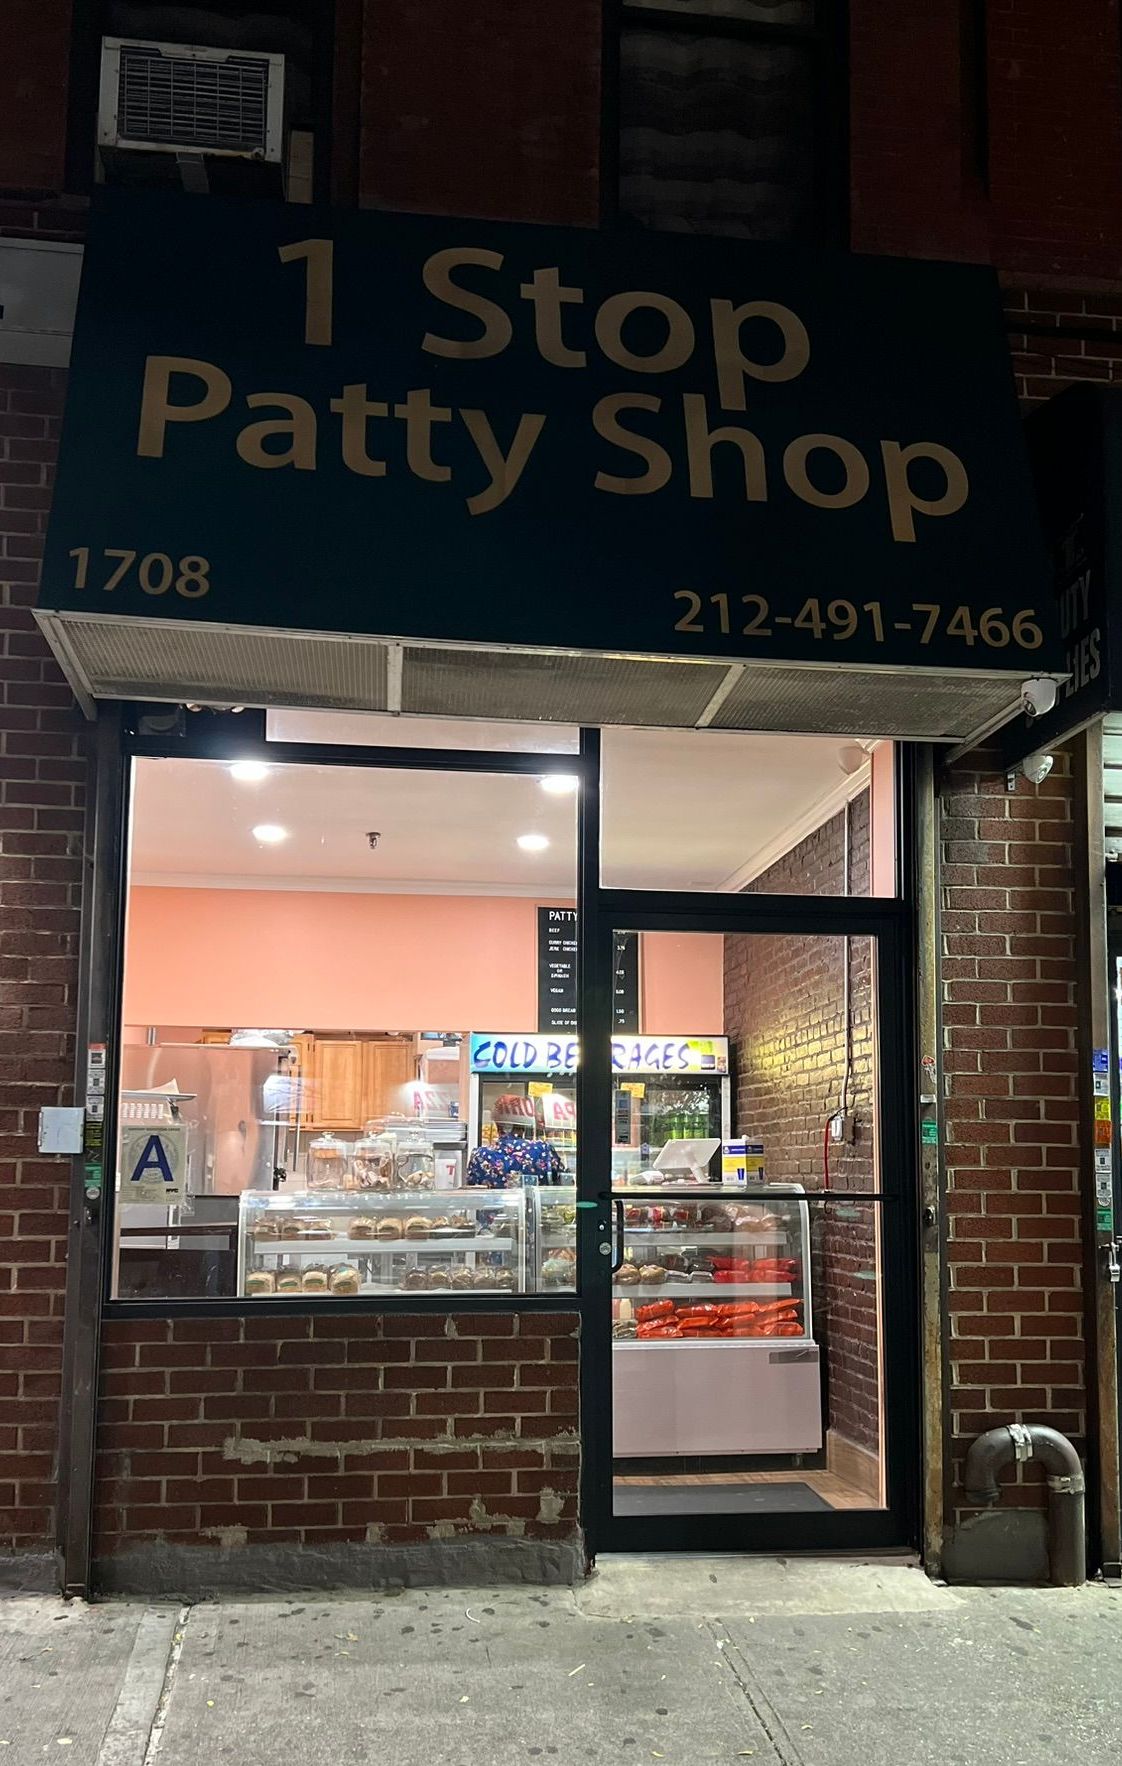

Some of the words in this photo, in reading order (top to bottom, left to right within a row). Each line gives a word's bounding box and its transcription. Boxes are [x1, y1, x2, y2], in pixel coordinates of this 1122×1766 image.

[278, 238, 334, 347] 1
[420, 247, 811, 412] Stop
[136, 355, 548, 516] Patty
[592, 392, 969, 543] Shop
[68, 546, 211, 598] 1708
[672, 589, 1044, 650] 212-491-7466
[473, 1040, 537, 1068] COLD
[547, 1041, 690, 1070] BERAGES
[130, 1134, 174, 1182] A
